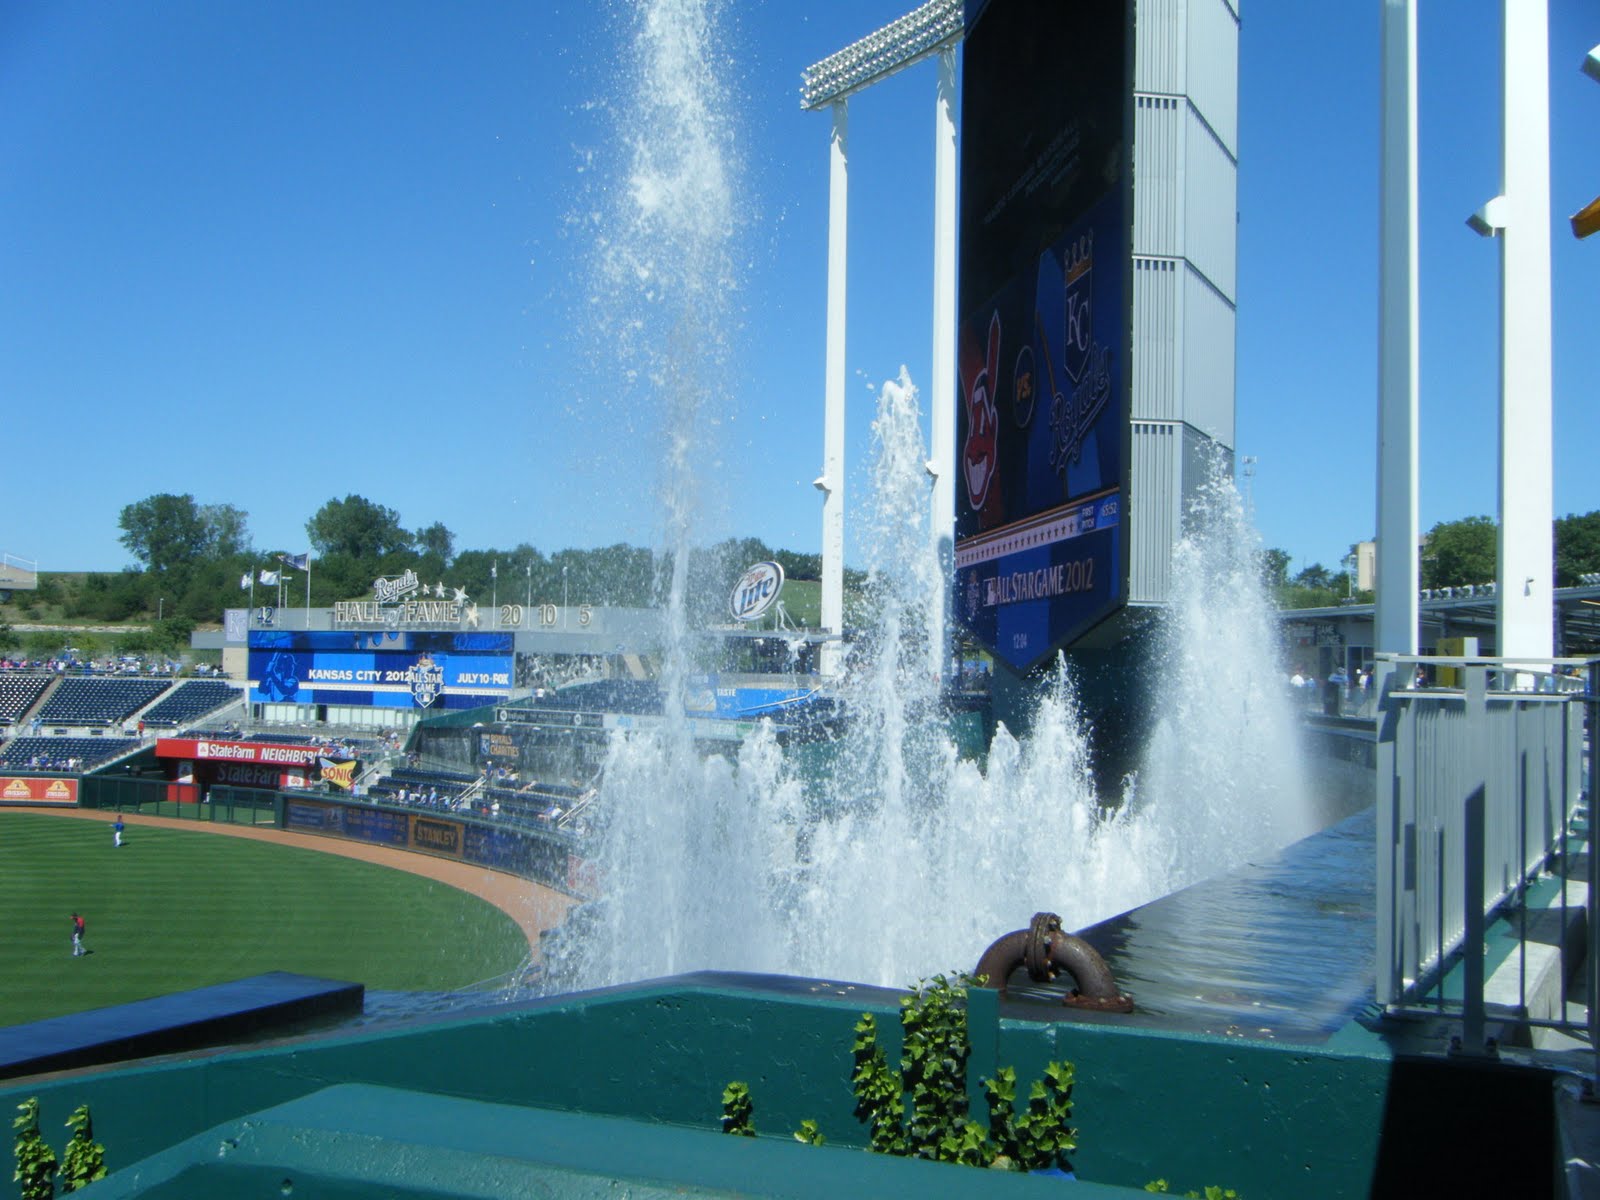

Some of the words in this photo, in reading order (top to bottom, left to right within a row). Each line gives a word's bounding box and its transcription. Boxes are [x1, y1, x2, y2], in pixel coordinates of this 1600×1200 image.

[1065, 558, 1094, 591] 2012
[374, 568, 419, 602] Royals
[257, 606, 274, 624] 42
[335, 601, 384, 623] HALL
[386, 604, 404, 627] of
[405, 601, 460, 623] FAME
[501, 605, 522, 625] 20
[538, 604, 558, 625] 10
[579, 604, 593, 626] 5
[308, 669, 353, 681] KANSAS
[356, 670, 381, 681] CITY
[386, 670, 410, 682] 2012
[457, 673, 479, 684] JULY
[415, 683, 436, 693] GAME
[321, 766, 353, 781] SONIC
[417, 825, 456, 847] STANLEY
